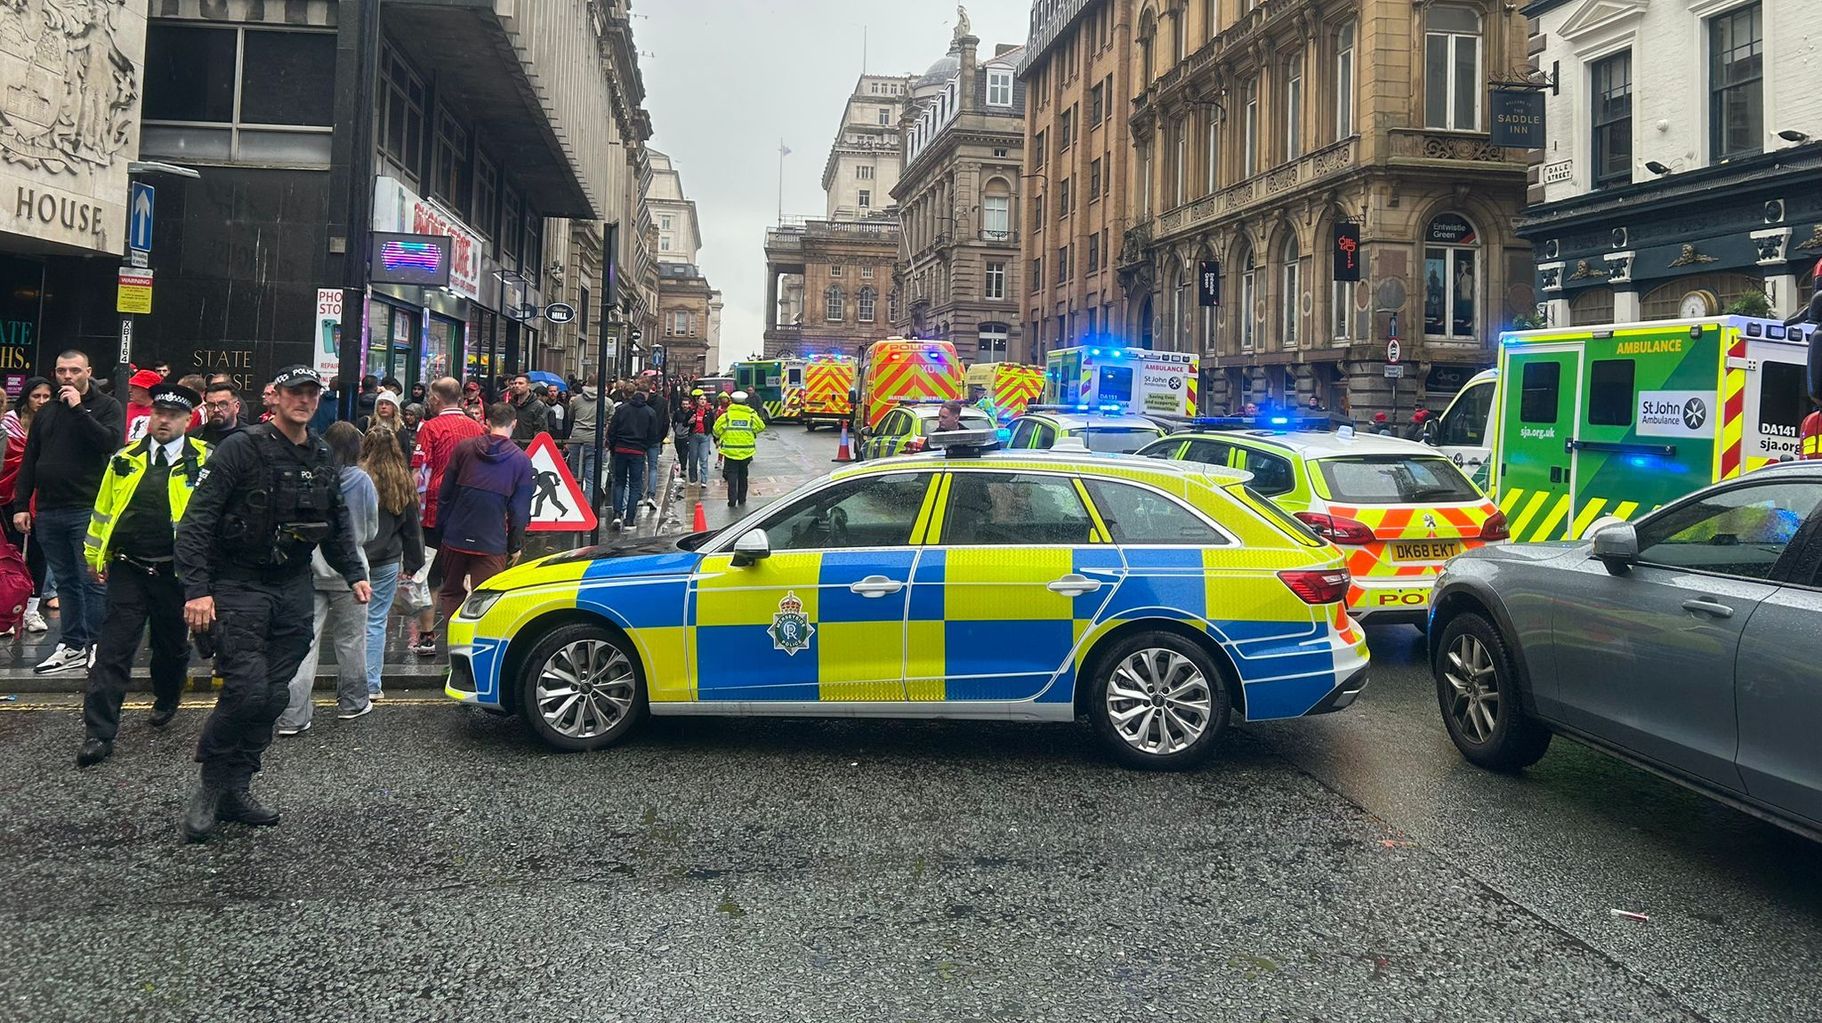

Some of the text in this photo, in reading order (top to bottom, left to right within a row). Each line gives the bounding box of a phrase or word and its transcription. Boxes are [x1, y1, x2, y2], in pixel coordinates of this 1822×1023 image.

[1498, 114, 1540, 124] SADDLE
[1510, 126, 1528, 134] INN
[1548, 164, 1568, 174] DALE
[1547, 171, 1570, 181] STREET
[16, 186, 102, 236] HOUSE
[1433, 223, 1466, 231] Entwistle
[1433, 231, 1456, 239] Green
[319, 292, 343, 302] PHO
[319, 303, 342, 314] STO
[551, 311, 567, 320] HILL
[1616, 339, 1682, 355] AMBULANCE
[193, 350, 252, 368] STATE
[1145, 364, 1183, 373] AMBULANCE
[1152, 376, 1167, 384] John
[1642, 401, 1680, 415] St John
[1642, 416, 1680, 426] Ambulance
[1520, 426, 1555, 439] sja.org.uk
[1761, 423, 1796, 437] DA141
[1760, 437, 1800, 456] sja.org
[1396, 543, 1455, 558] DK68 EKT
[776, 614, 806, 628] MERSEYSIDE
